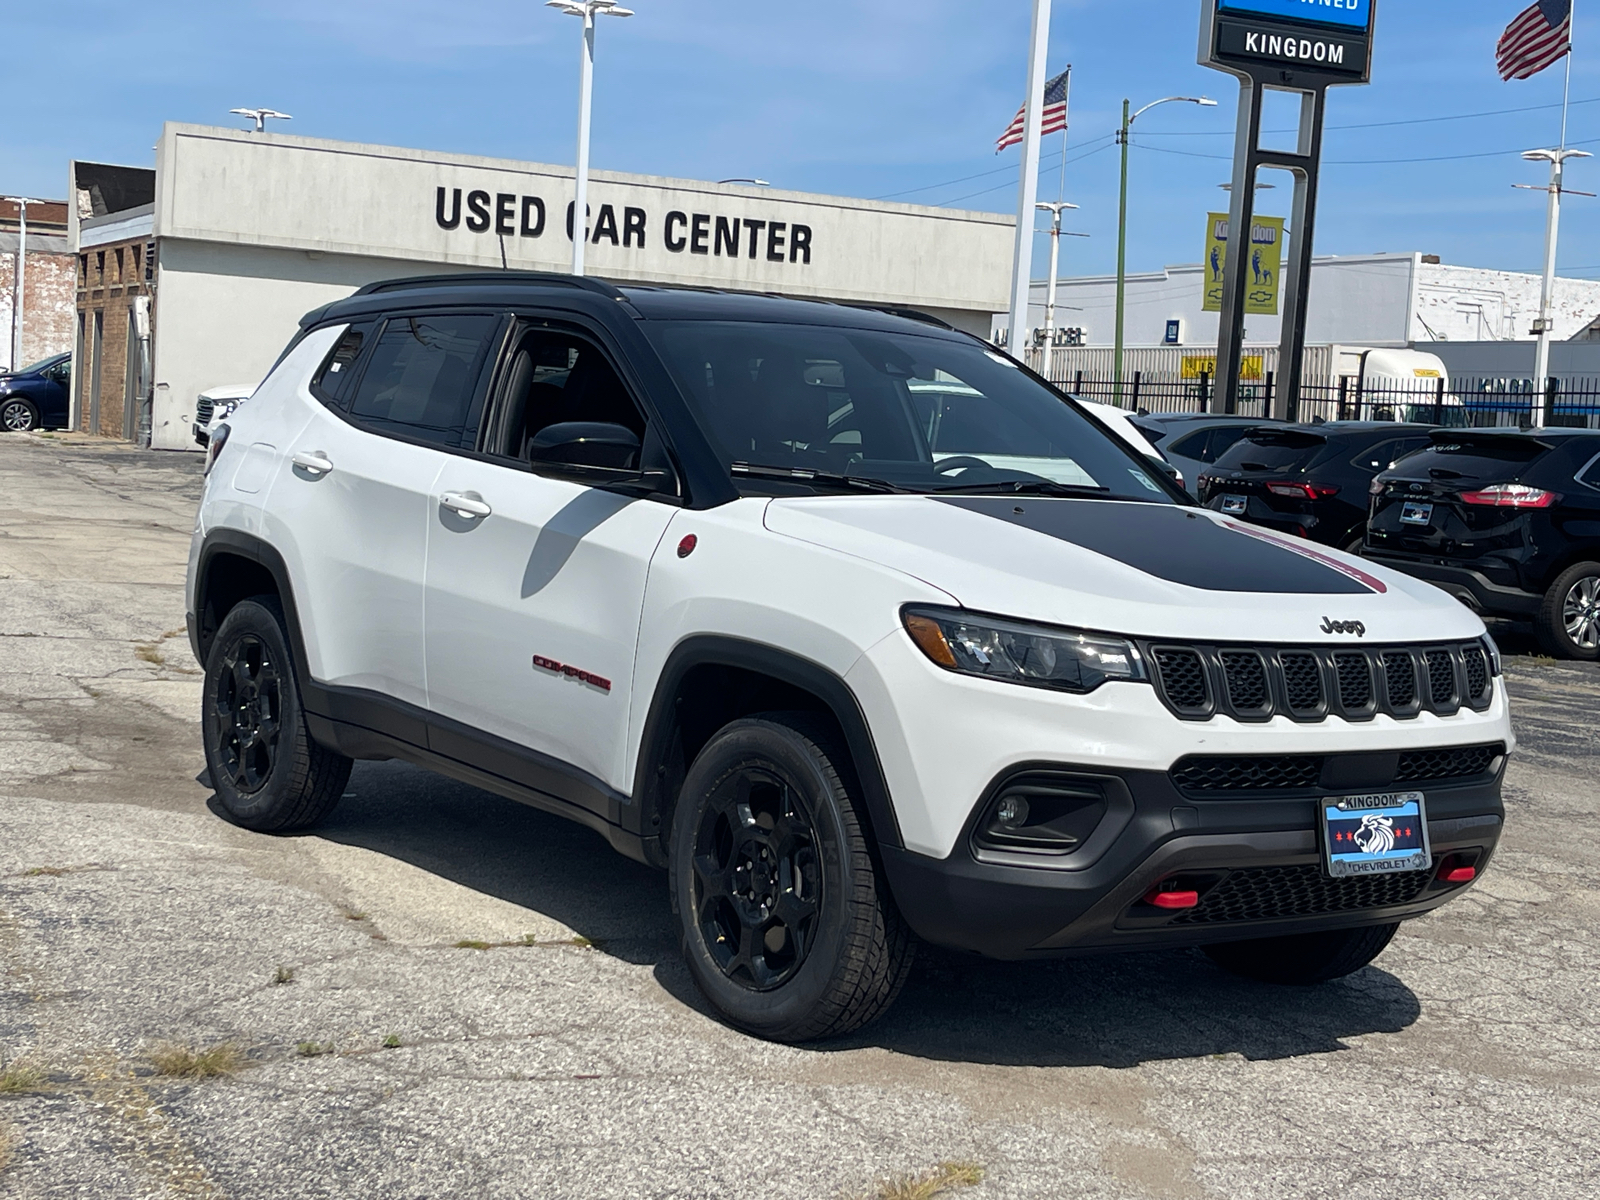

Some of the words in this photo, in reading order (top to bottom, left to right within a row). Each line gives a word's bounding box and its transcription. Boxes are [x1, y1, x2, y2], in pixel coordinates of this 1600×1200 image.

[1245, 32, 1344, 64] KINGDOM
[436, 186, 545, 237] USED
[664, 210, 812, 264] CENTER
[1319, 616, 1366, 637] Jeep
[1345, 794, 1398, 808] KINGDOM
